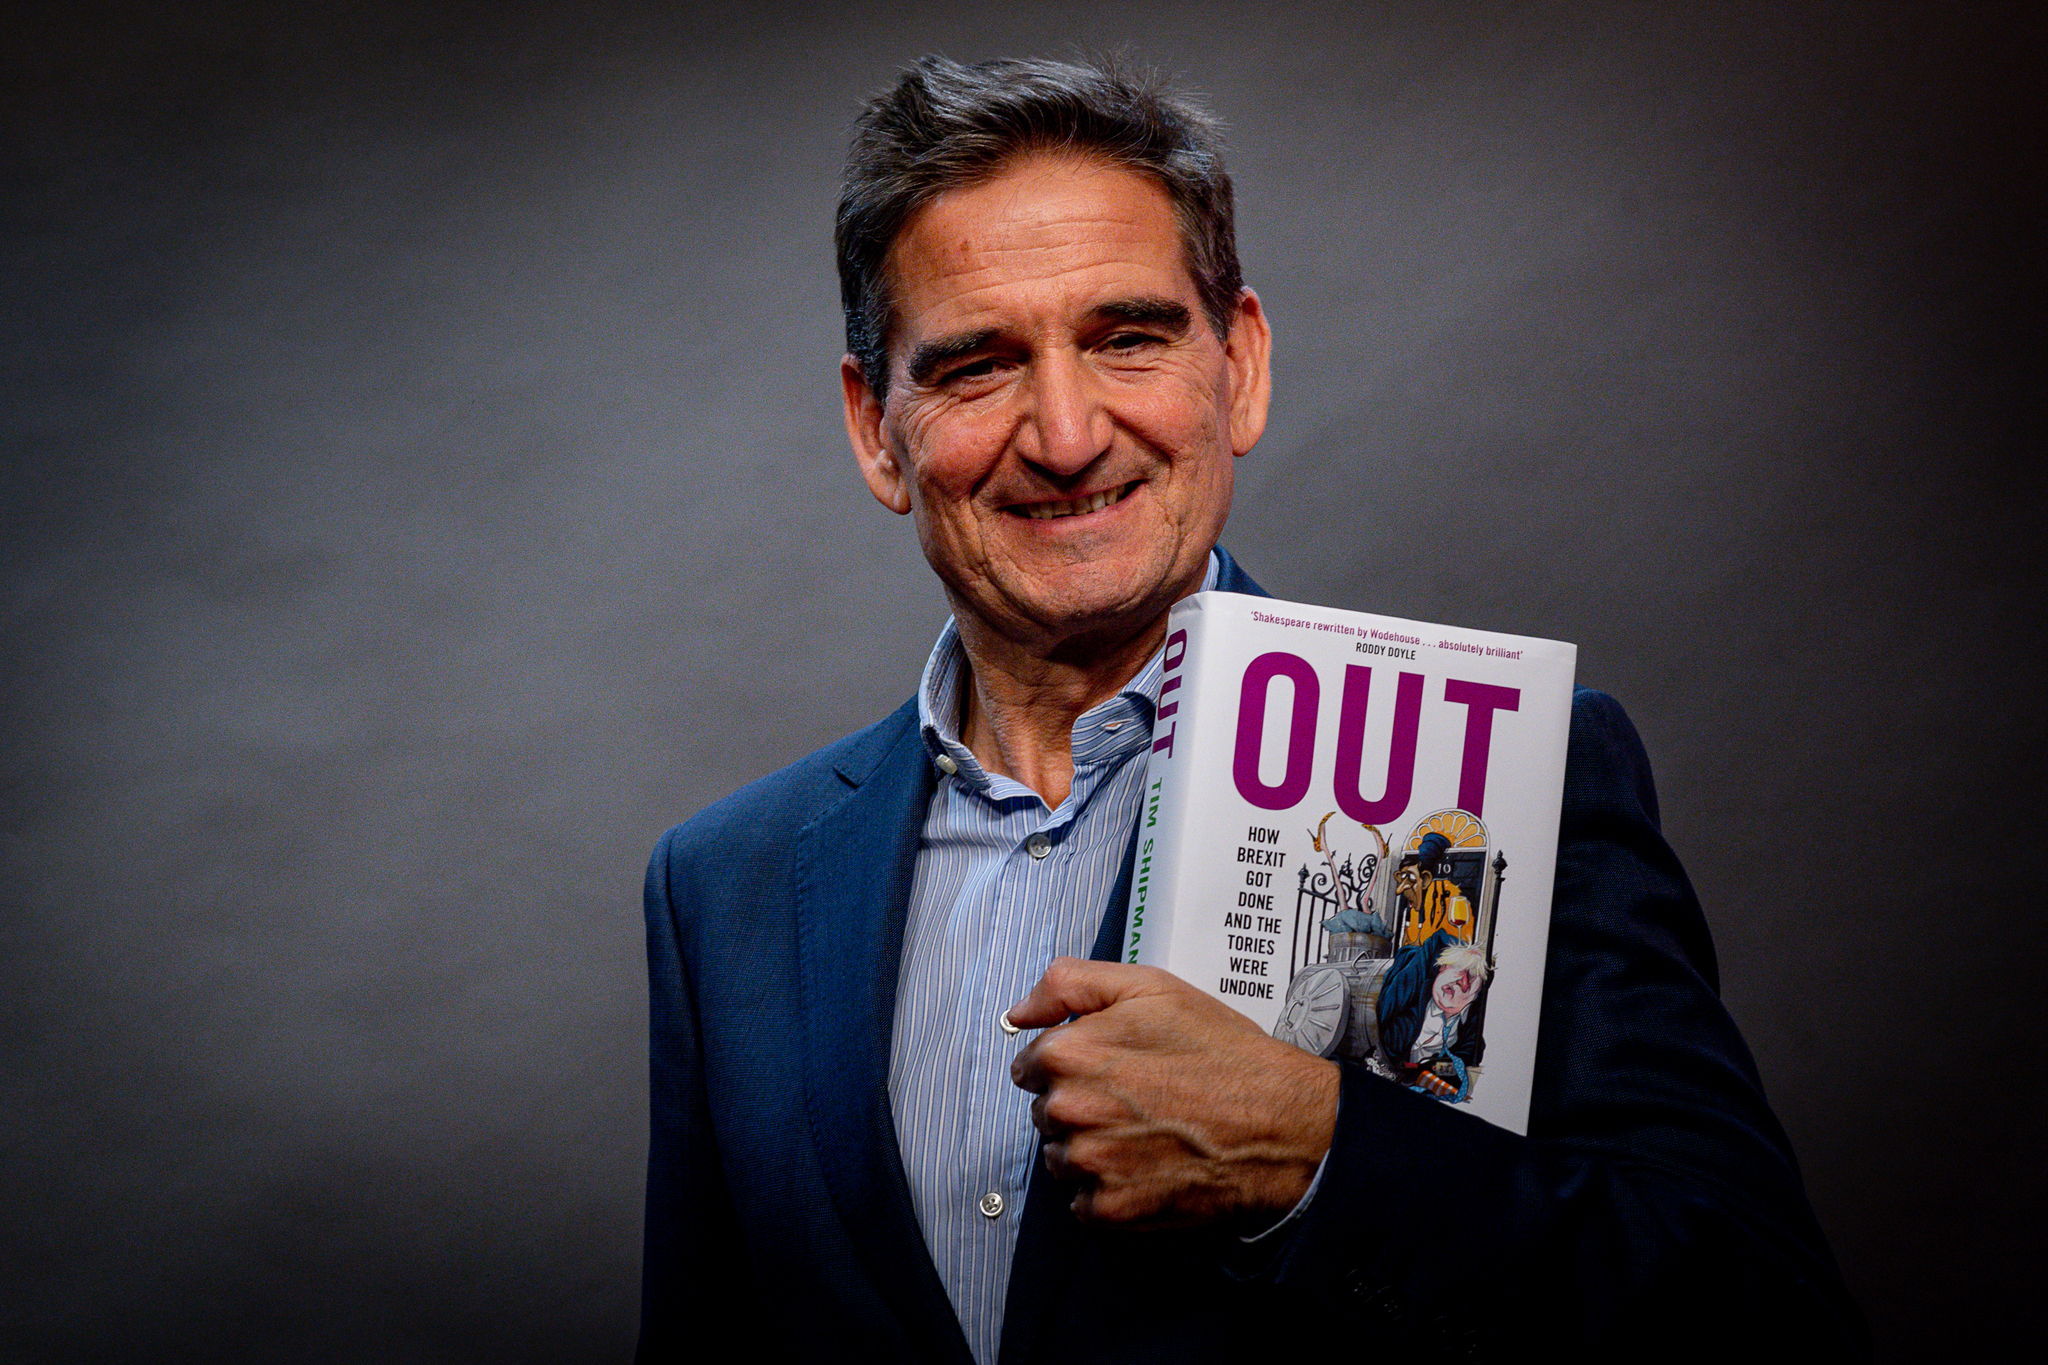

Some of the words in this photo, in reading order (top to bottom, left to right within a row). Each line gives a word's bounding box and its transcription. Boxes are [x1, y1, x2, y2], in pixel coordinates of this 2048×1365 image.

[1313, 622, 1355, 636] rewritten
[1357, 626, 1368, 640] by
[1370, 628, 1420, 646] Wodehouse
[1438, 639, 1484, 657] absolutely
[1355, 642, 1387, 657] RODDY
[1388, 646, 1417, 661] DOYLE
[1151, 628, 1188, 760] OUT
[1232, 651, 1522, 826] OUT
[1146, 776, 1163, 829] TIM
[1247, 826, 1280, 845] HOW
[1236, 846, 1287, 868] BREXIT
[1245, 870, 1273, 889] GOT
[1437, 863, 1452, 875] 10
[1238, 891, 1275, 911] DONE
[1224, 912, 1252, 930] AND
[1257, 916, 1282, 935] THE
[1227, 934, 1275, 956] TORIES
[1229, 956, 1269, 977] WERE
[1219, 977, 1275, 1000] UNDONE
